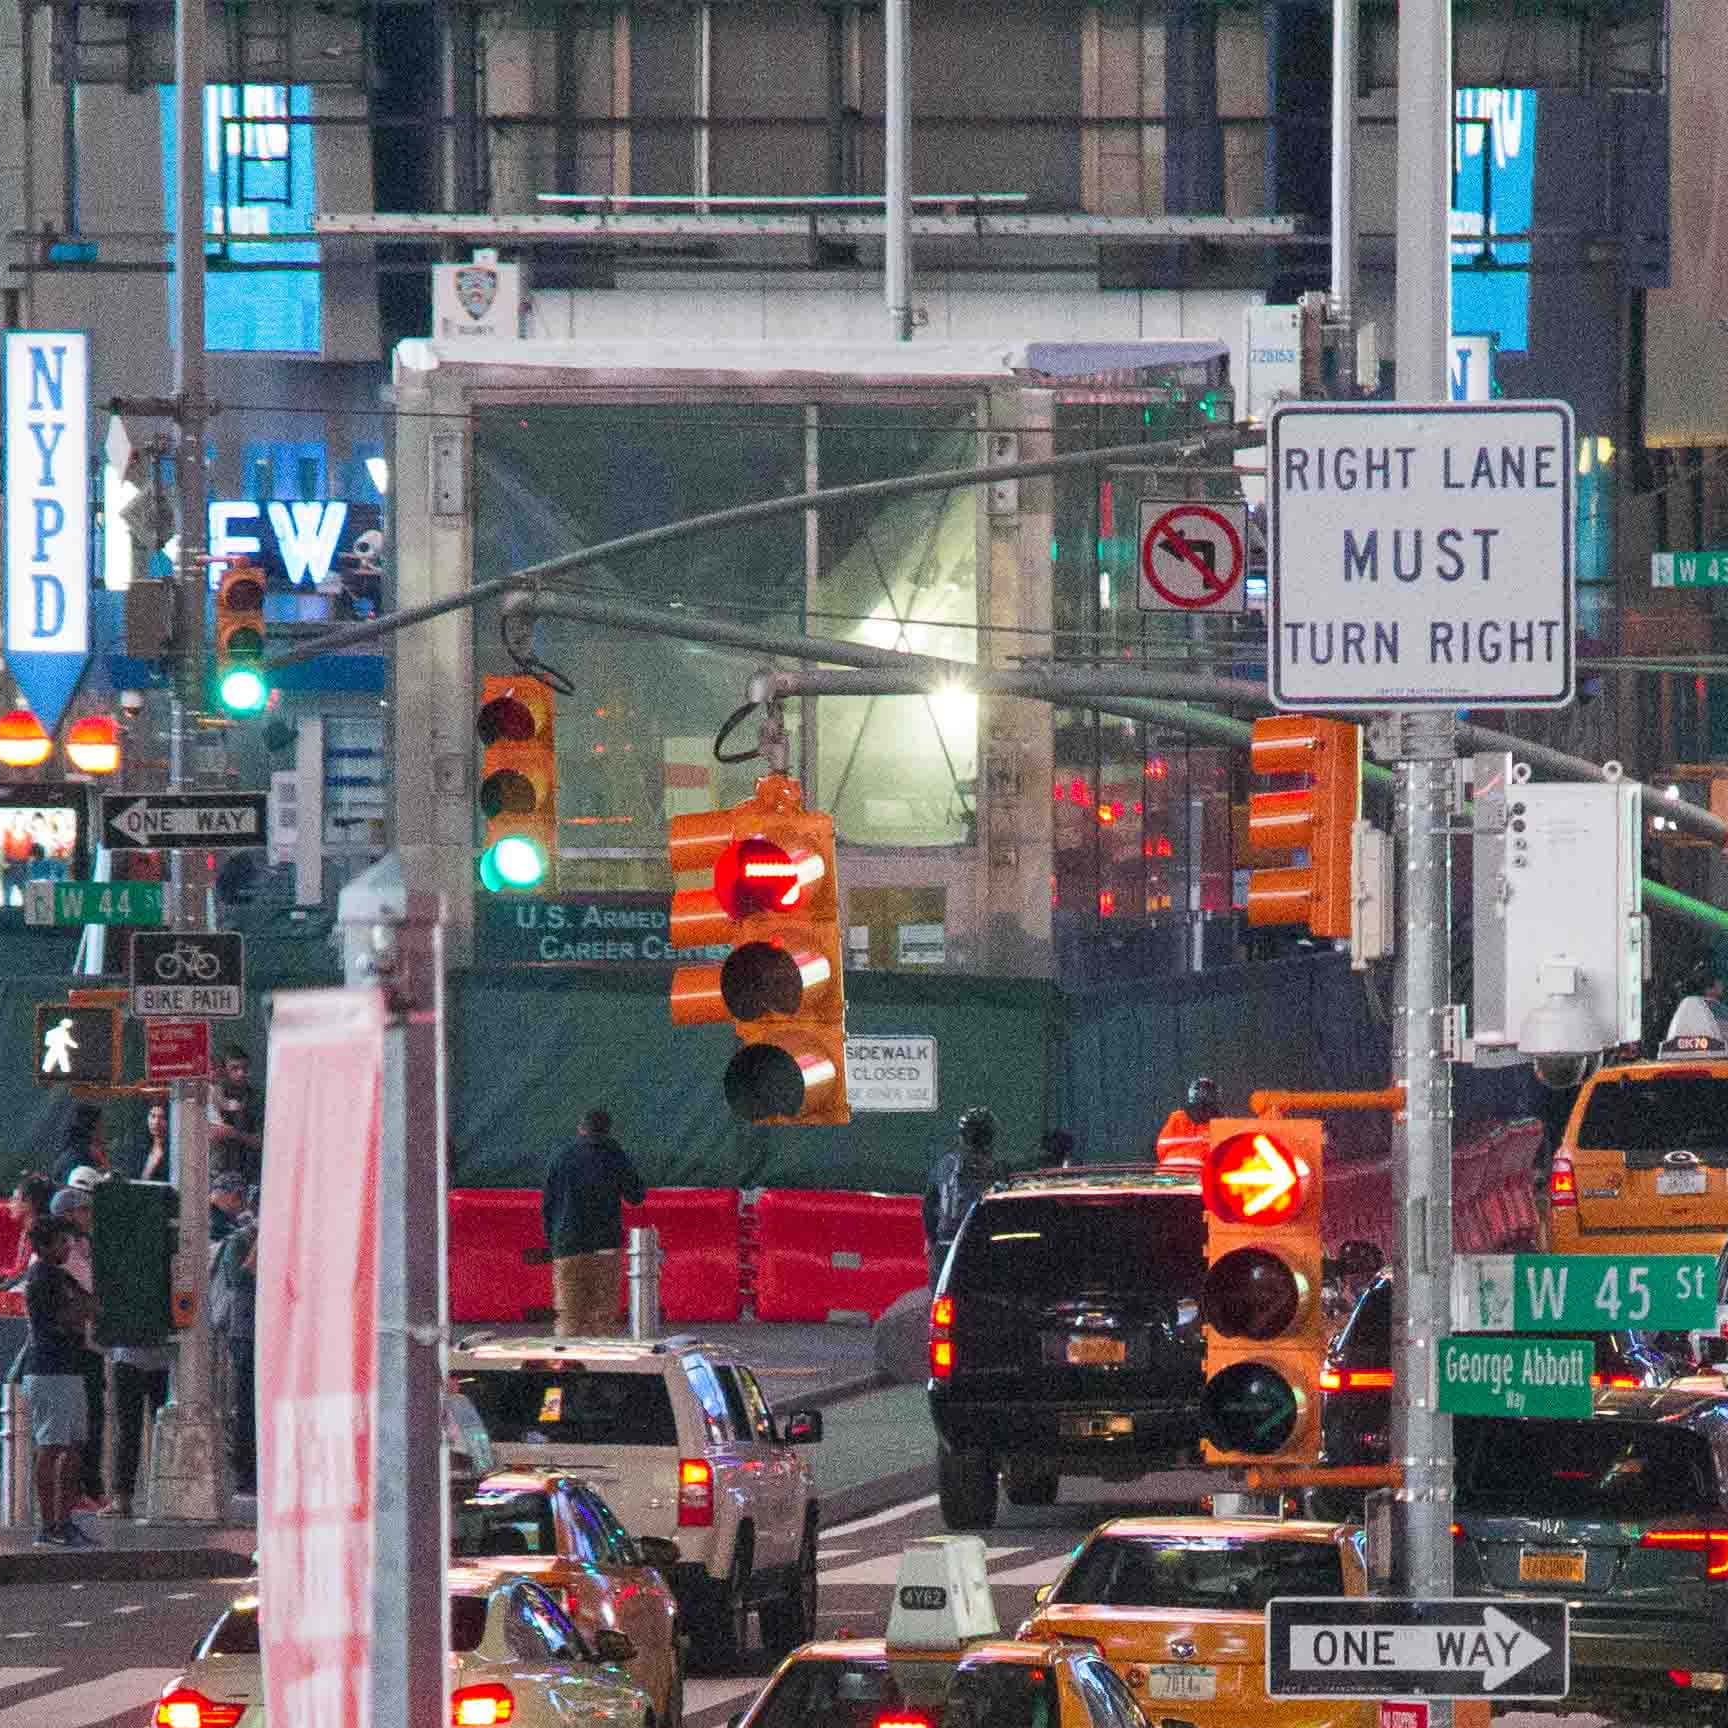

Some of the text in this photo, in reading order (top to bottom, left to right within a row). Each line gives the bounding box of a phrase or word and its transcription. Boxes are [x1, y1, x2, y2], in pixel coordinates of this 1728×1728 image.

[1286, 446, 1559, 490] RIGHT LANE
[29, 346, 67, 637] NYPD
[1343, 528, 1500, 582] MUST
[1679, 558, 1698, 582] W
[1286, 621, 1561, 665] TURN RIGHT
[127, 808, 246, 834] ONE WAY
[54, 889, 83, 919] W
[99, 888, 134, 918] 44
[516, 905, 573, 930] U.S.
[143, 988, 234, 1010] BIKE PATH
[846, 1045, 930, 1061] SIDEWALK
[852, 1067, 921, 1082] CLOSED
[1526, 1263, 1706, 1320] W 45 St
[1445, 1343, 1586, 1388] George Abbott
[1505, 1394, 1525, 1410] Way
[1313, 1629, 1522, 1667] ONE WAY
